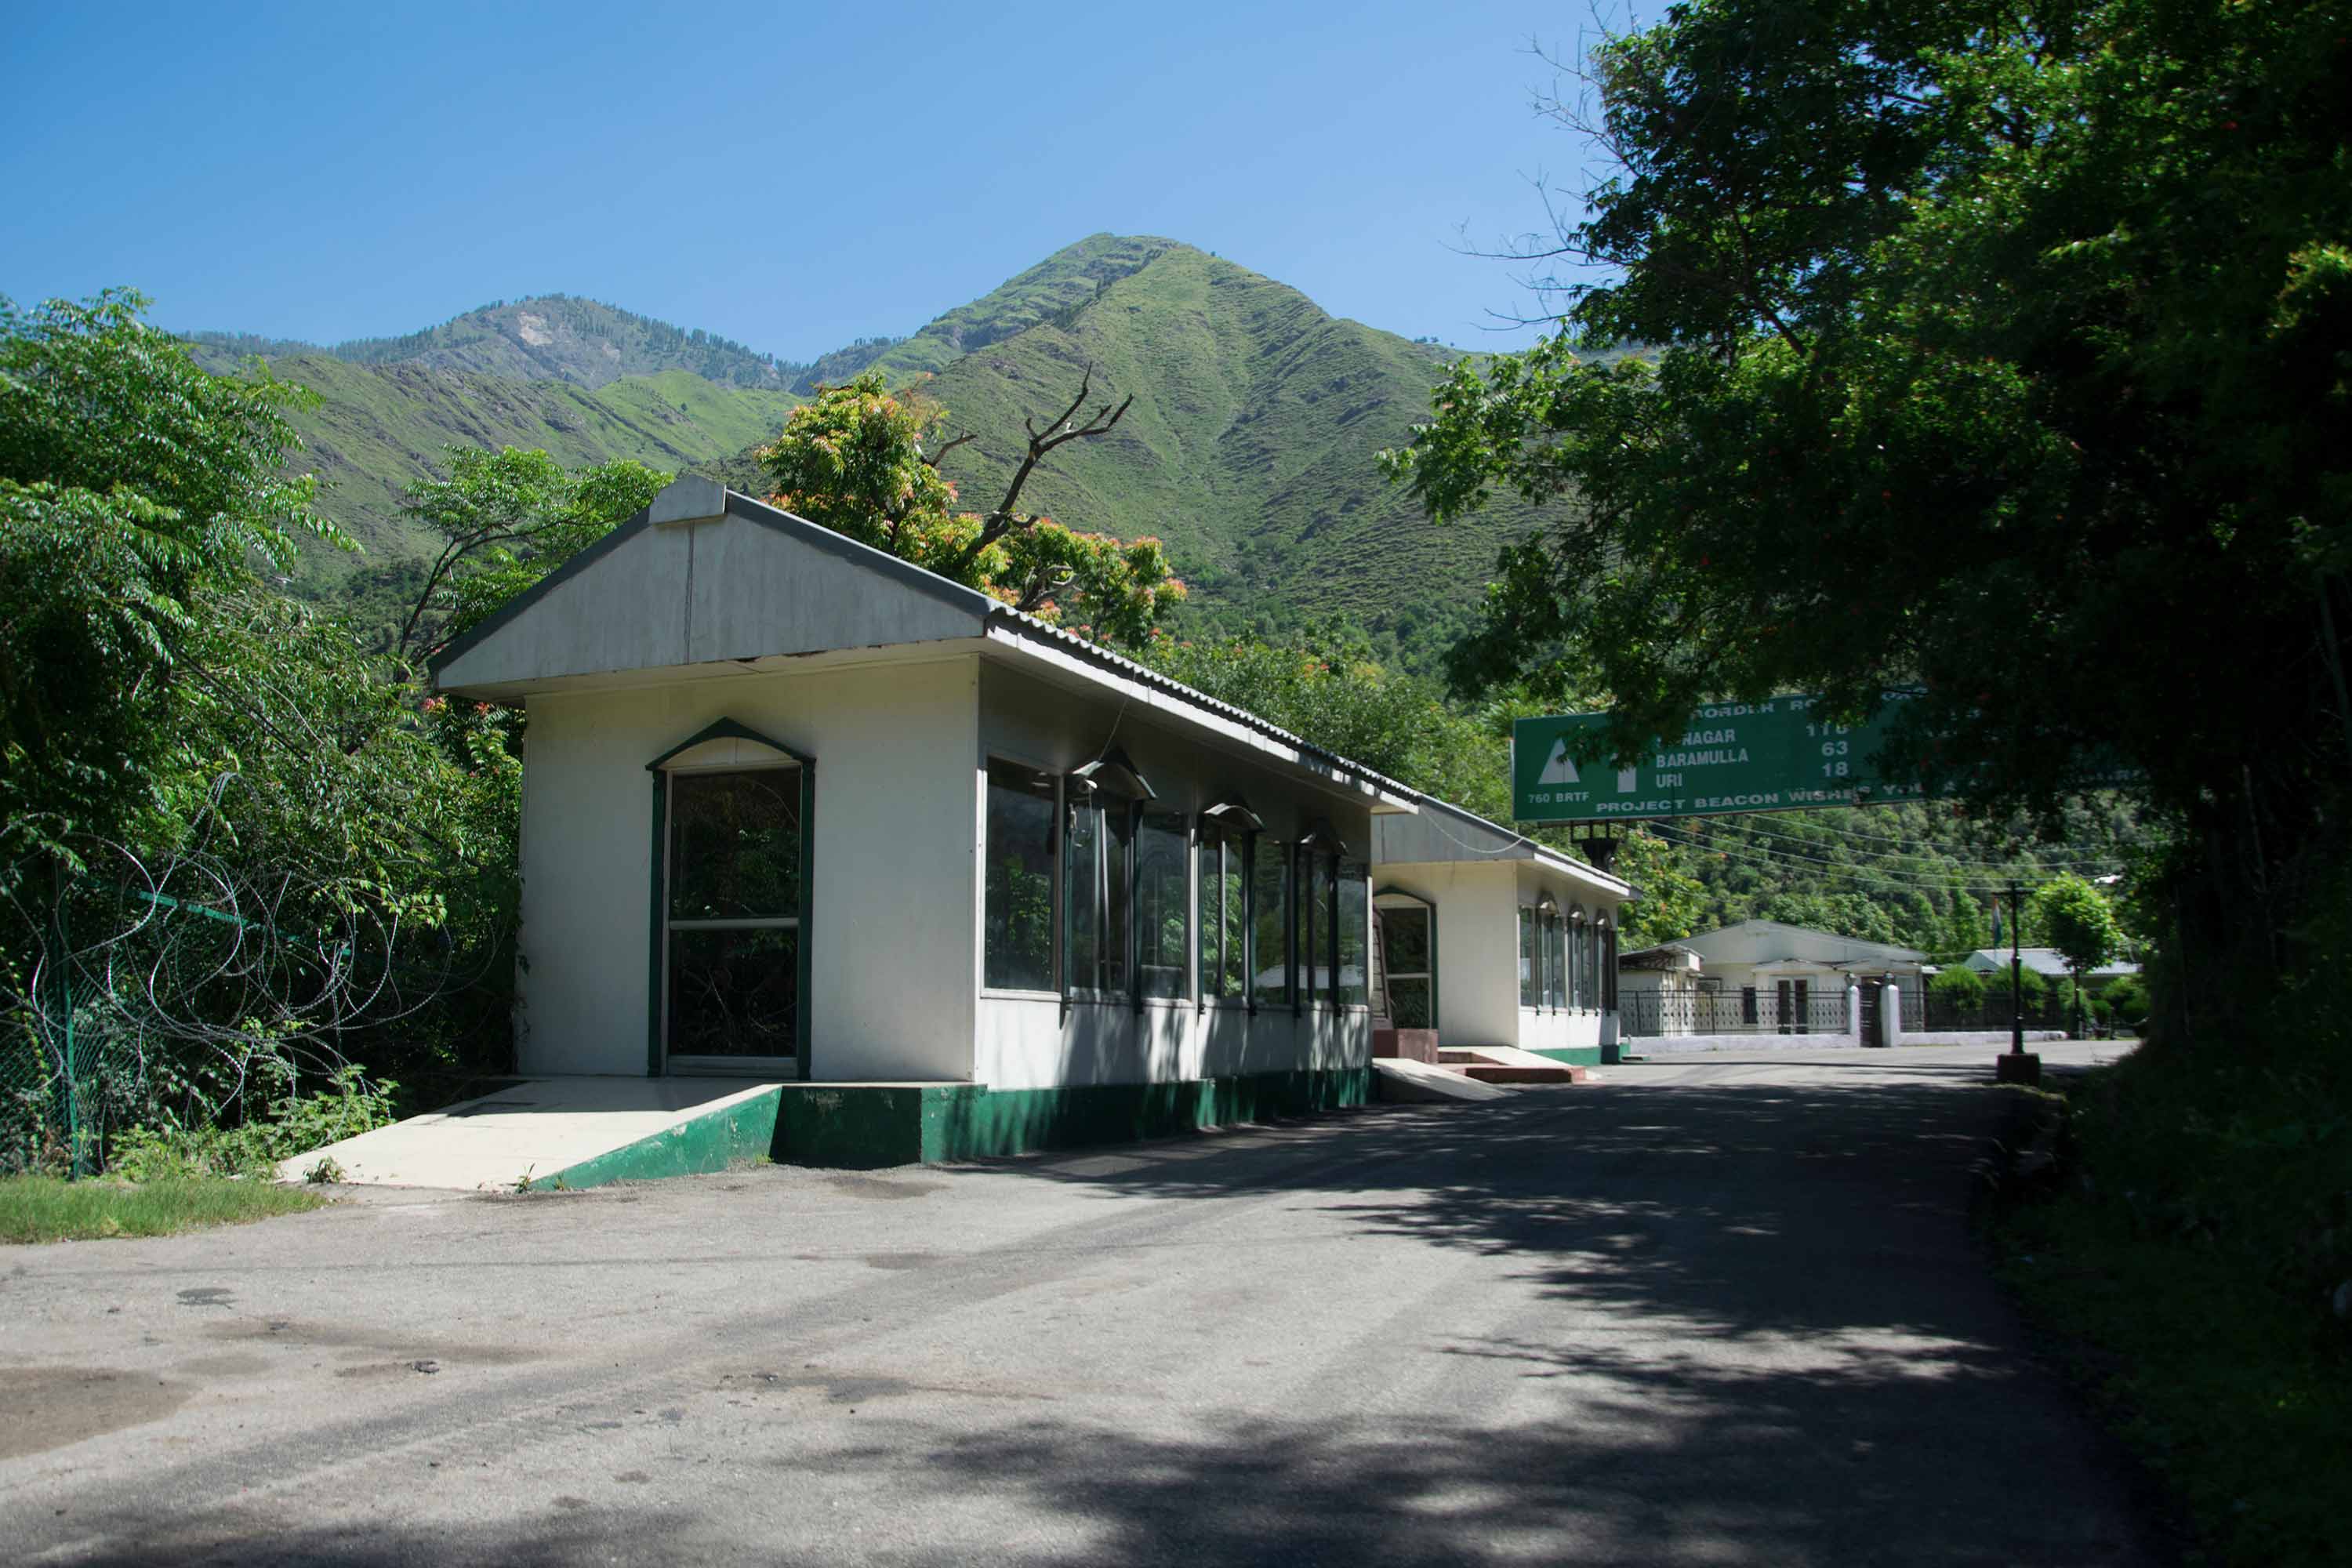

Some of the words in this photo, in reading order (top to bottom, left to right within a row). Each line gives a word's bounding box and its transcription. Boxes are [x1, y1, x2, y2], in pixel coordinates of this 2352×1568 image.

[1656, 728, 1736, 748] NAGAR
[1656, 747, 1749, 768] BARAMULLA
[1821, 740, 1849, 757] 63
[1656, 772, 1682, 789] URI
[1821, 761, 1849, 777] 18
[1555, 792, 1590, 803] BRTF
[1596, 799, 1686, 813] PROJECT
[1694, 793, 1779, 808] BEACON
